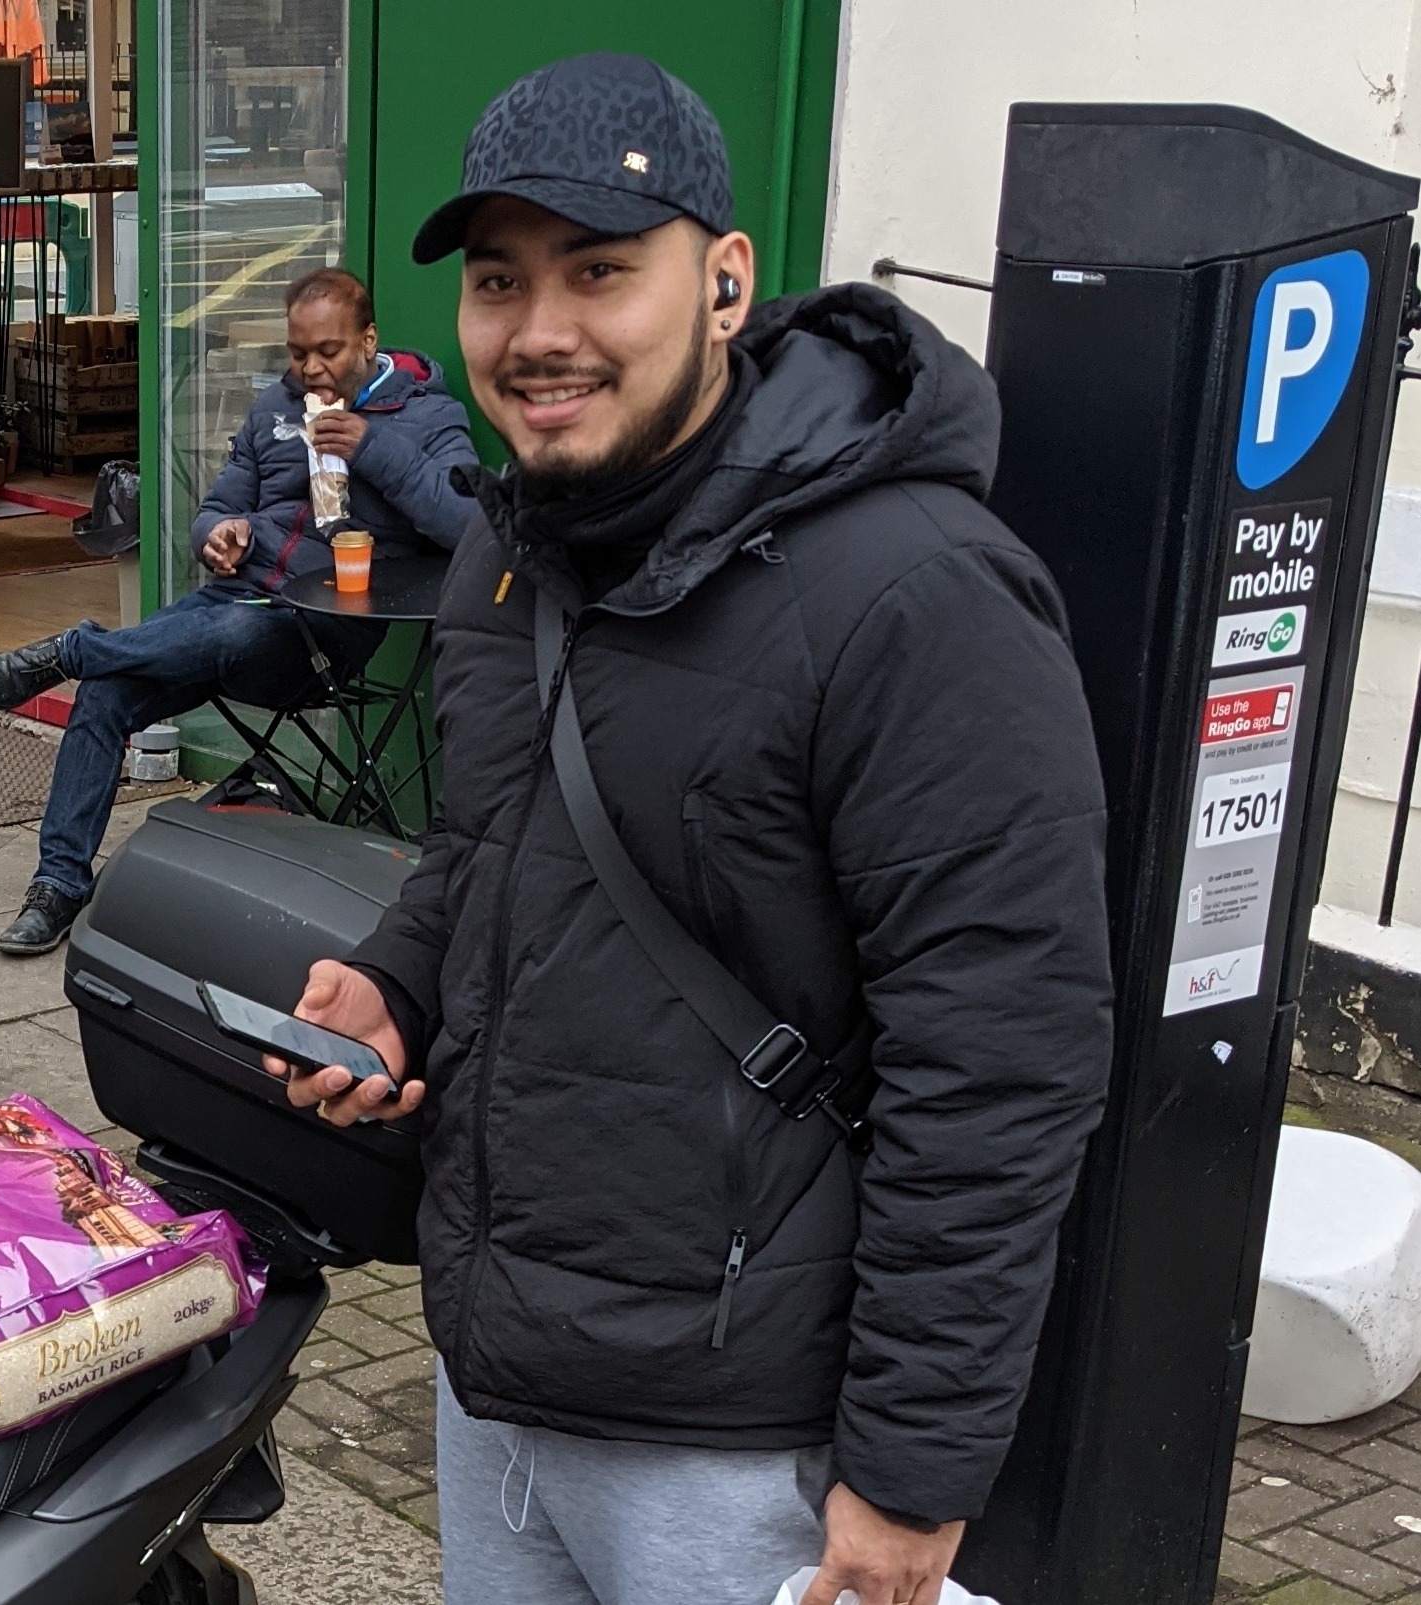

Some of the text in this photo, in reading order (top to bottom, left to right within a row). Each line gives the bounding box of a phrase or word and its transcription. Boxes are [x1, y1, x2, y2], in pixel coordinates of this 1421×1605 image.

[1255, 280, 1333, 444] P
[1235, 512, 1324, 559] Pay by
[1228, 558, 1315, 601] mobile
[1226, 621, 1293, 651] RingGo
[1208, 716, 1272, 737] RingGo app
[1211, 700, 1250, 718] Use the
[1202, 788, 1282, 838] 17501
[37, 1316, 142, 1380] Broken
[38, 1347, 146, 1404] BASMATI RICE
